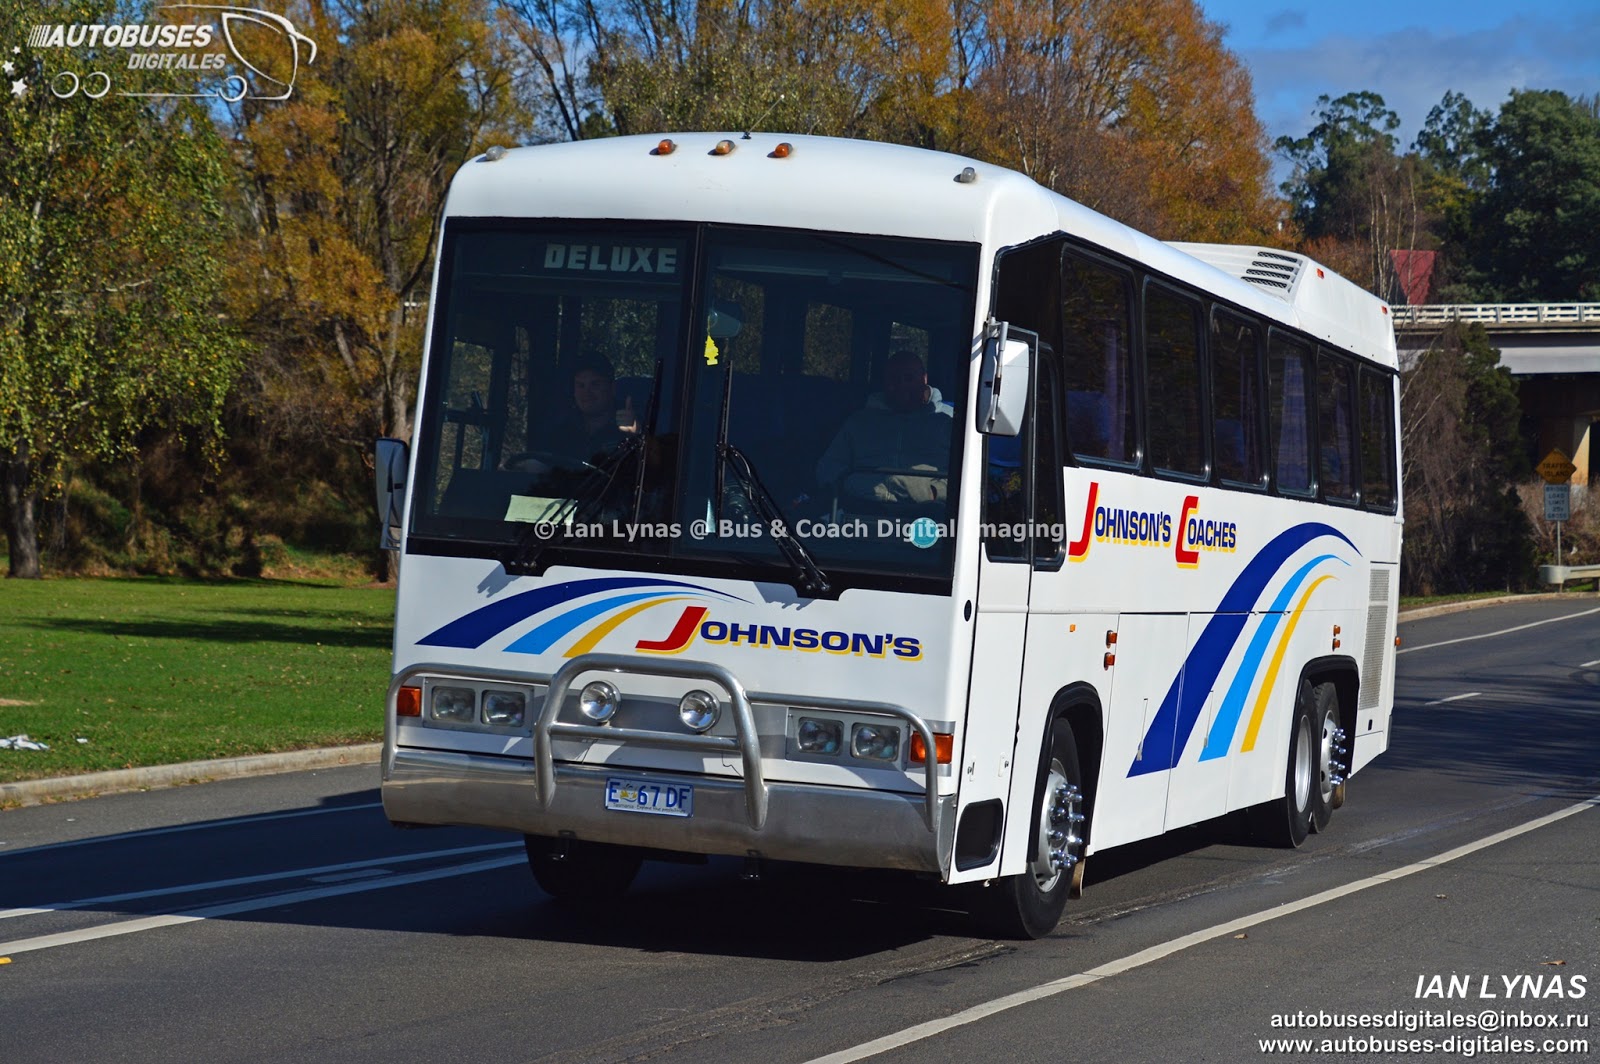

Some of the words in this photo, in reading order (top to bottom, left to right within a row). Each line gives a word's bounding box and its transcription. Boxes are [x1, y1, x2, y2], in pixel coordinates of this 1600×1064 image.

[544, 244, 677, 273] DELUXE
[1068, 481, 1172, 563] JOHNSON'S
[1175, 495, 1237, 569] COACHES
[635, 606, 923, 661] JOHNSON'S
[609, 782, 621, 803] E
[637, 785, 660, 807] 67
[666, 787, 690, 808] DF
